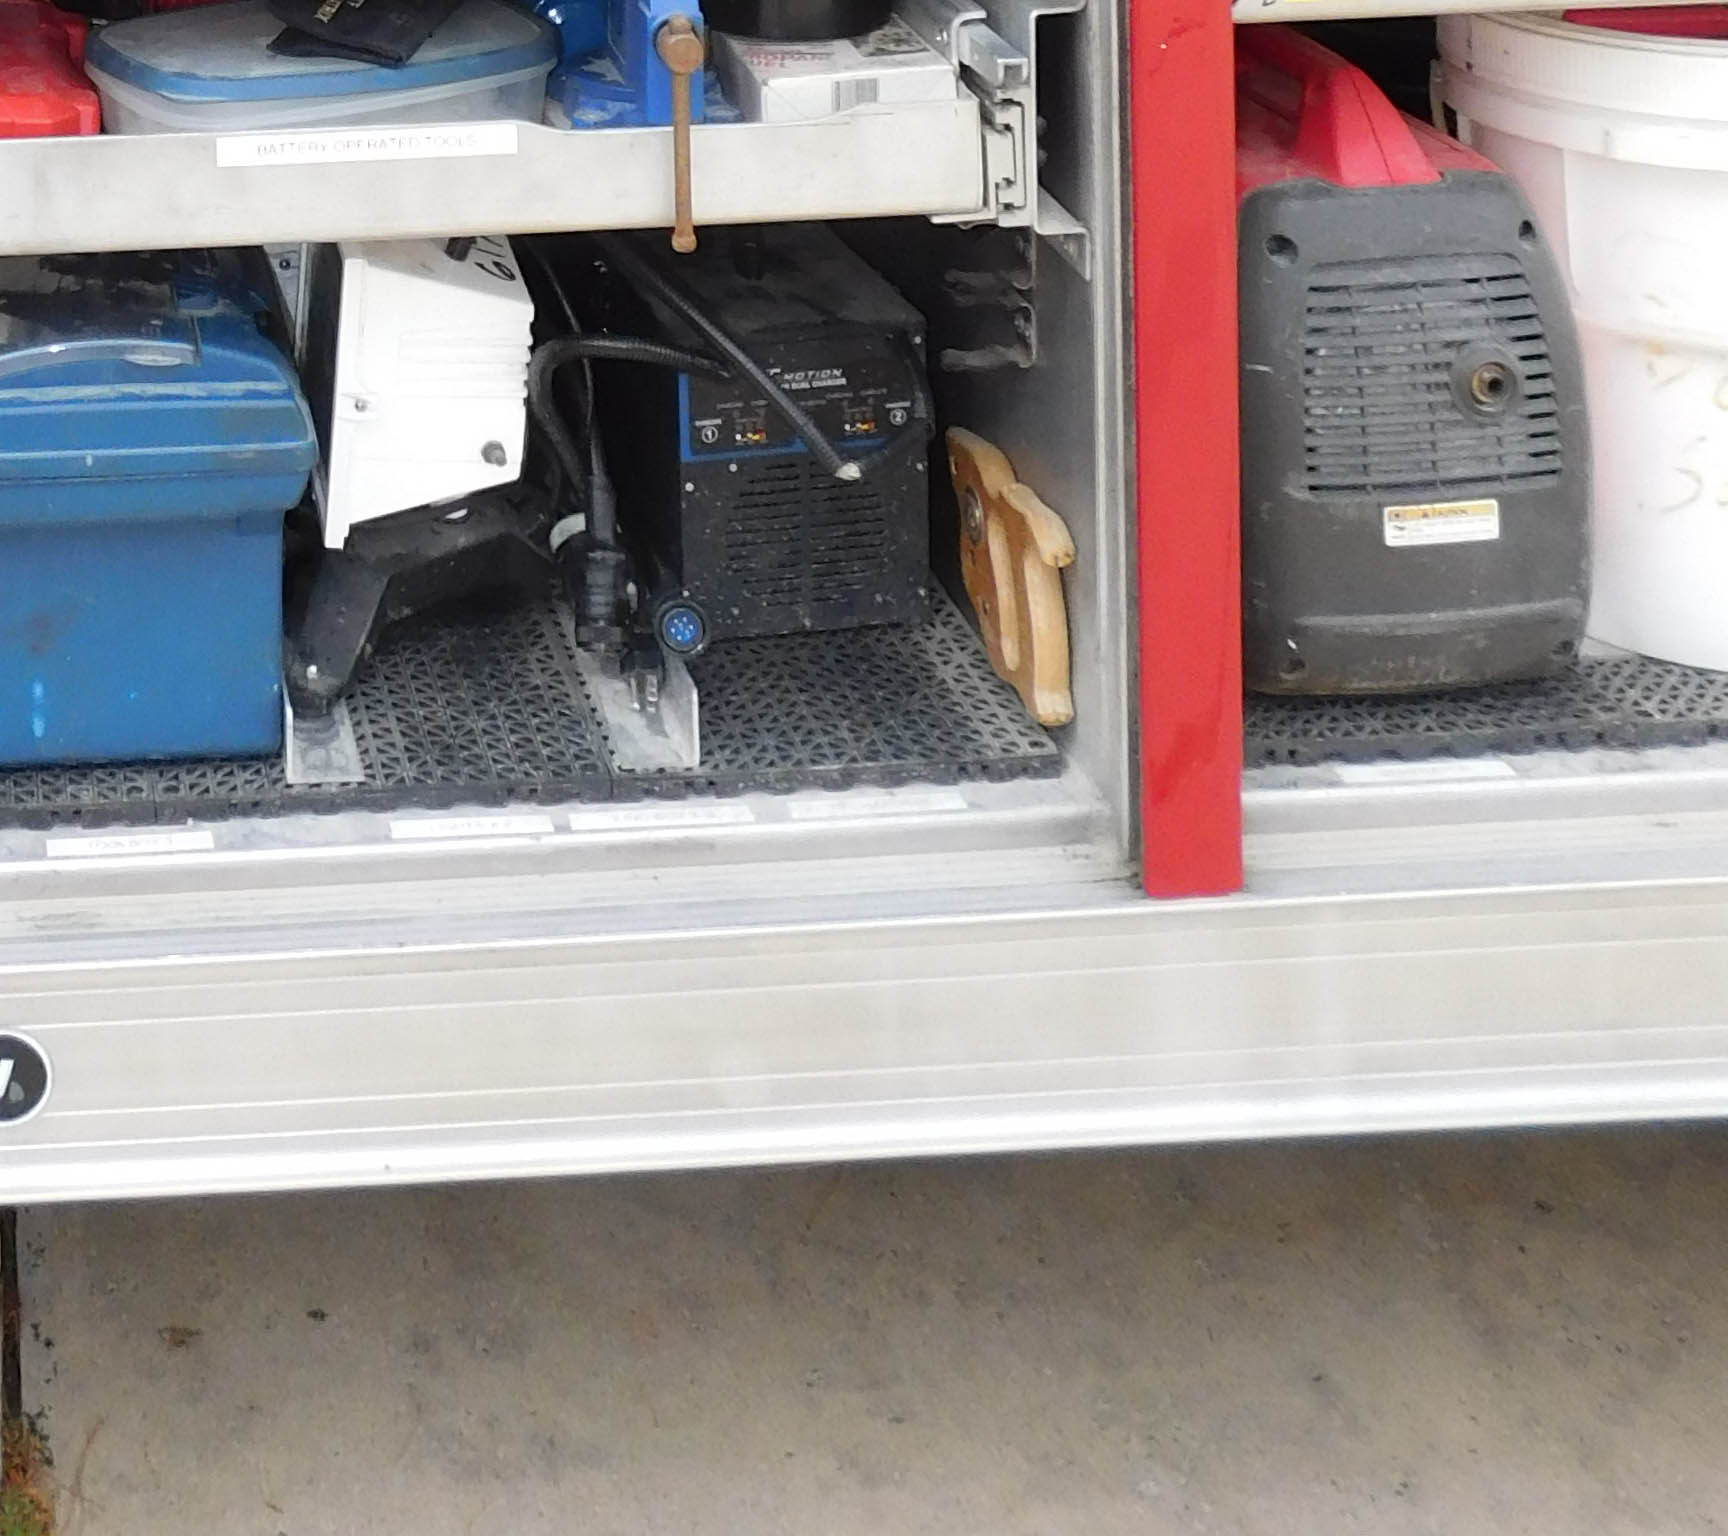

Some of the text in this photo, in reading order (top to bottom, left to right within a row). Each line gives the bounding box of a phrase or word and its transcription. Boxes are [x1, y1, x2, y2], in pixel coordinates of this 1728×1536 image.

[257, 134, 478, 157] BATTERY OPERATED TOOLS
